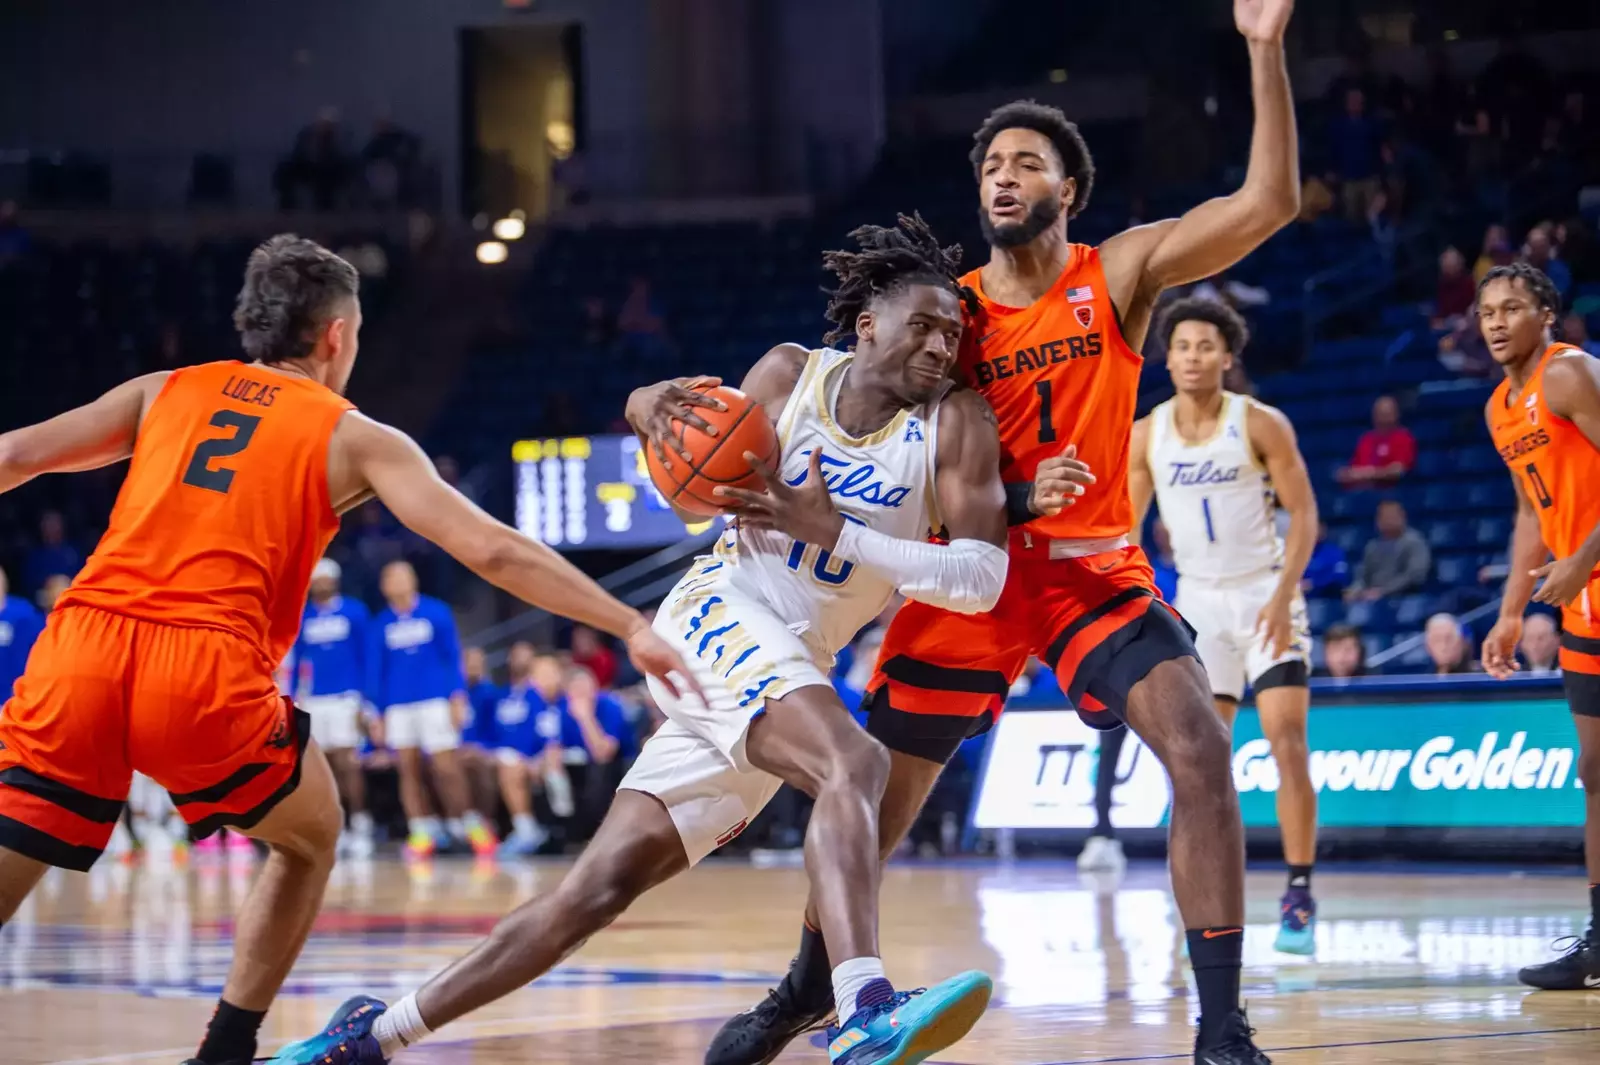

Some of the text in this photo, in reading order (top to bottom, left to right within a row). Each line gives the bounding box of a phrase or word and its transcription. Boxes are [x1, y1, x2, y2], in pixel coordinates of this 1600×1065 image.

[973, 332, 1104, 386] BEAVERS
[221, 374, 282, 407] LUCAS
[1036, 379, 1057, 444] 1
[182, 409, 264, 494] 2
[1169, 459, 1242, 488] Tulsa
[784, 450, 913, 508] Tulsa
[1526, 462, 1553, 509] 0
[1202, 498, 1216, 542] 1
[1036, 744, 1142, 786] TTU
[1308, 750, 1412, 794] your
[1409, 731, 1574, 791] Golden
